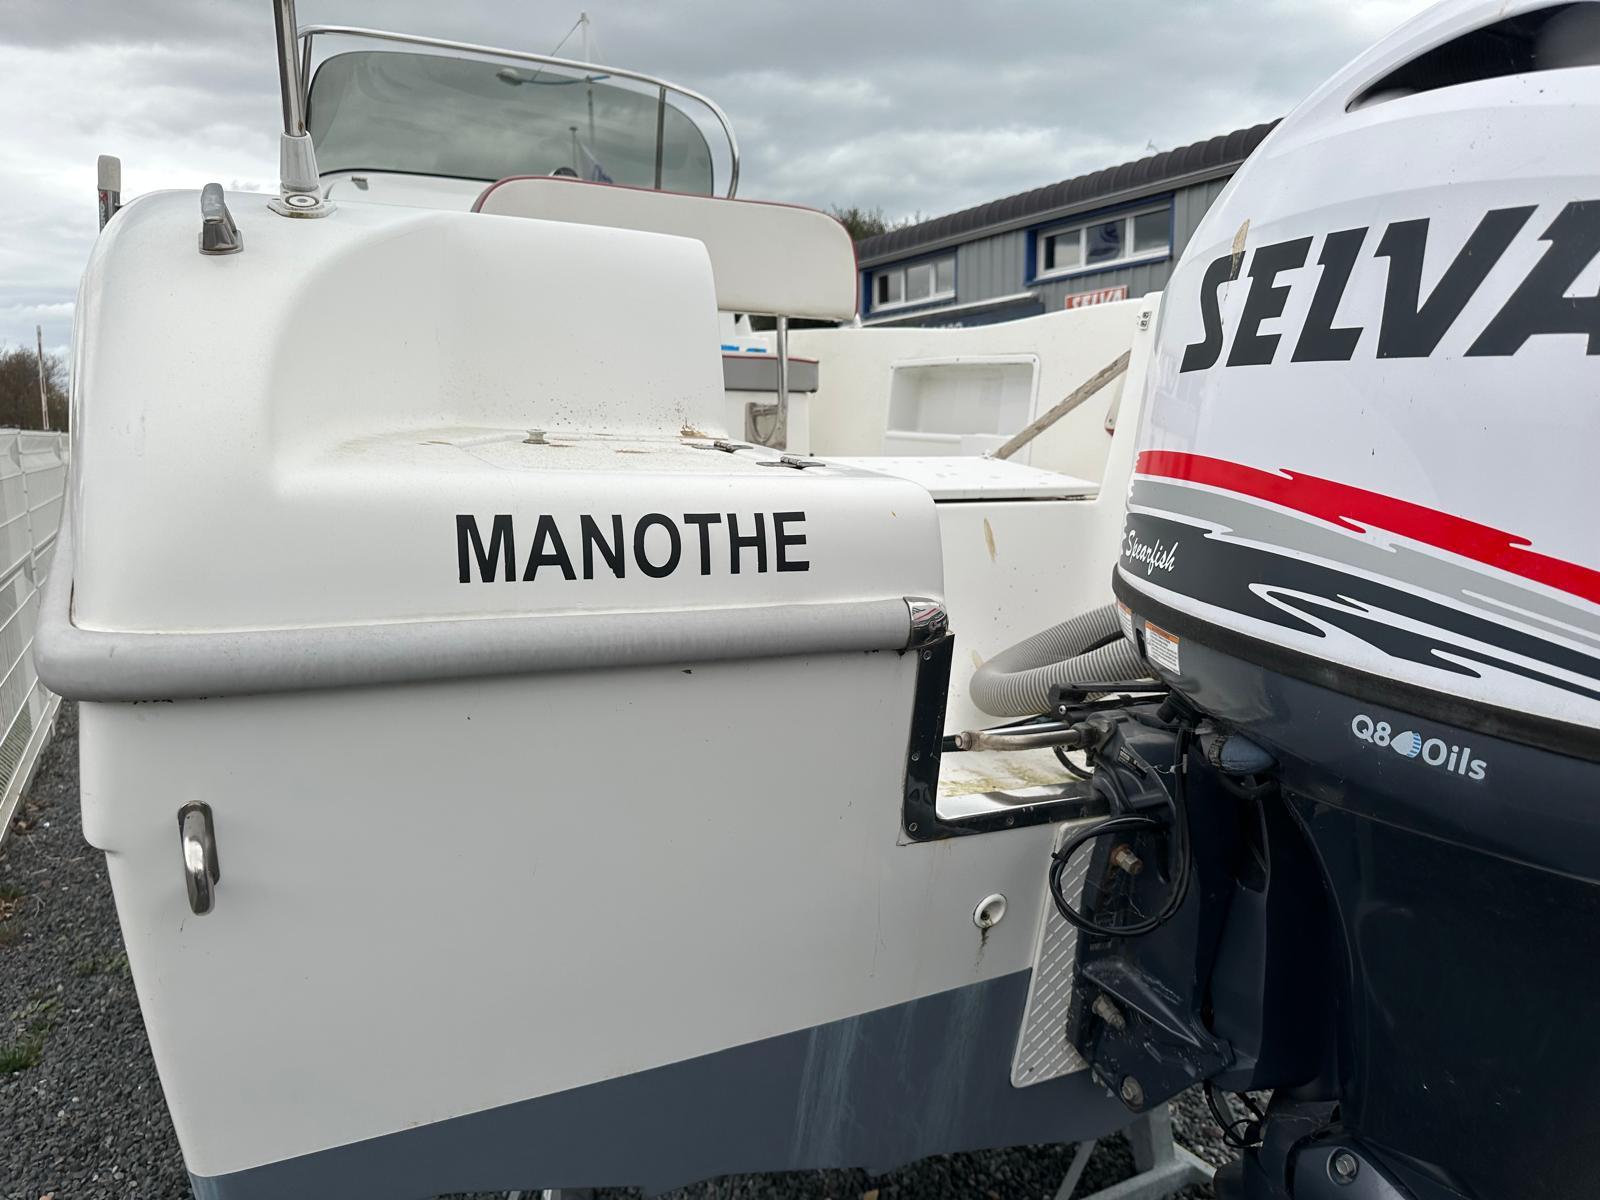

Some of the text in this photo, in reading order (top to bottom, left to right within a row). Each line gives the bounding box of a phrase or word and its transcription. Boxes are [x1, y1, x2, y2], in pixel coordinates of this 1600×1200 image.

[1180, 200, 1600, 373] SELVA
[456, 511, 810, 583] MANOTHE
[1125, 529, 1178, 576] Spearfish
[1351, 714, 1488, 780] Q8 Oils
